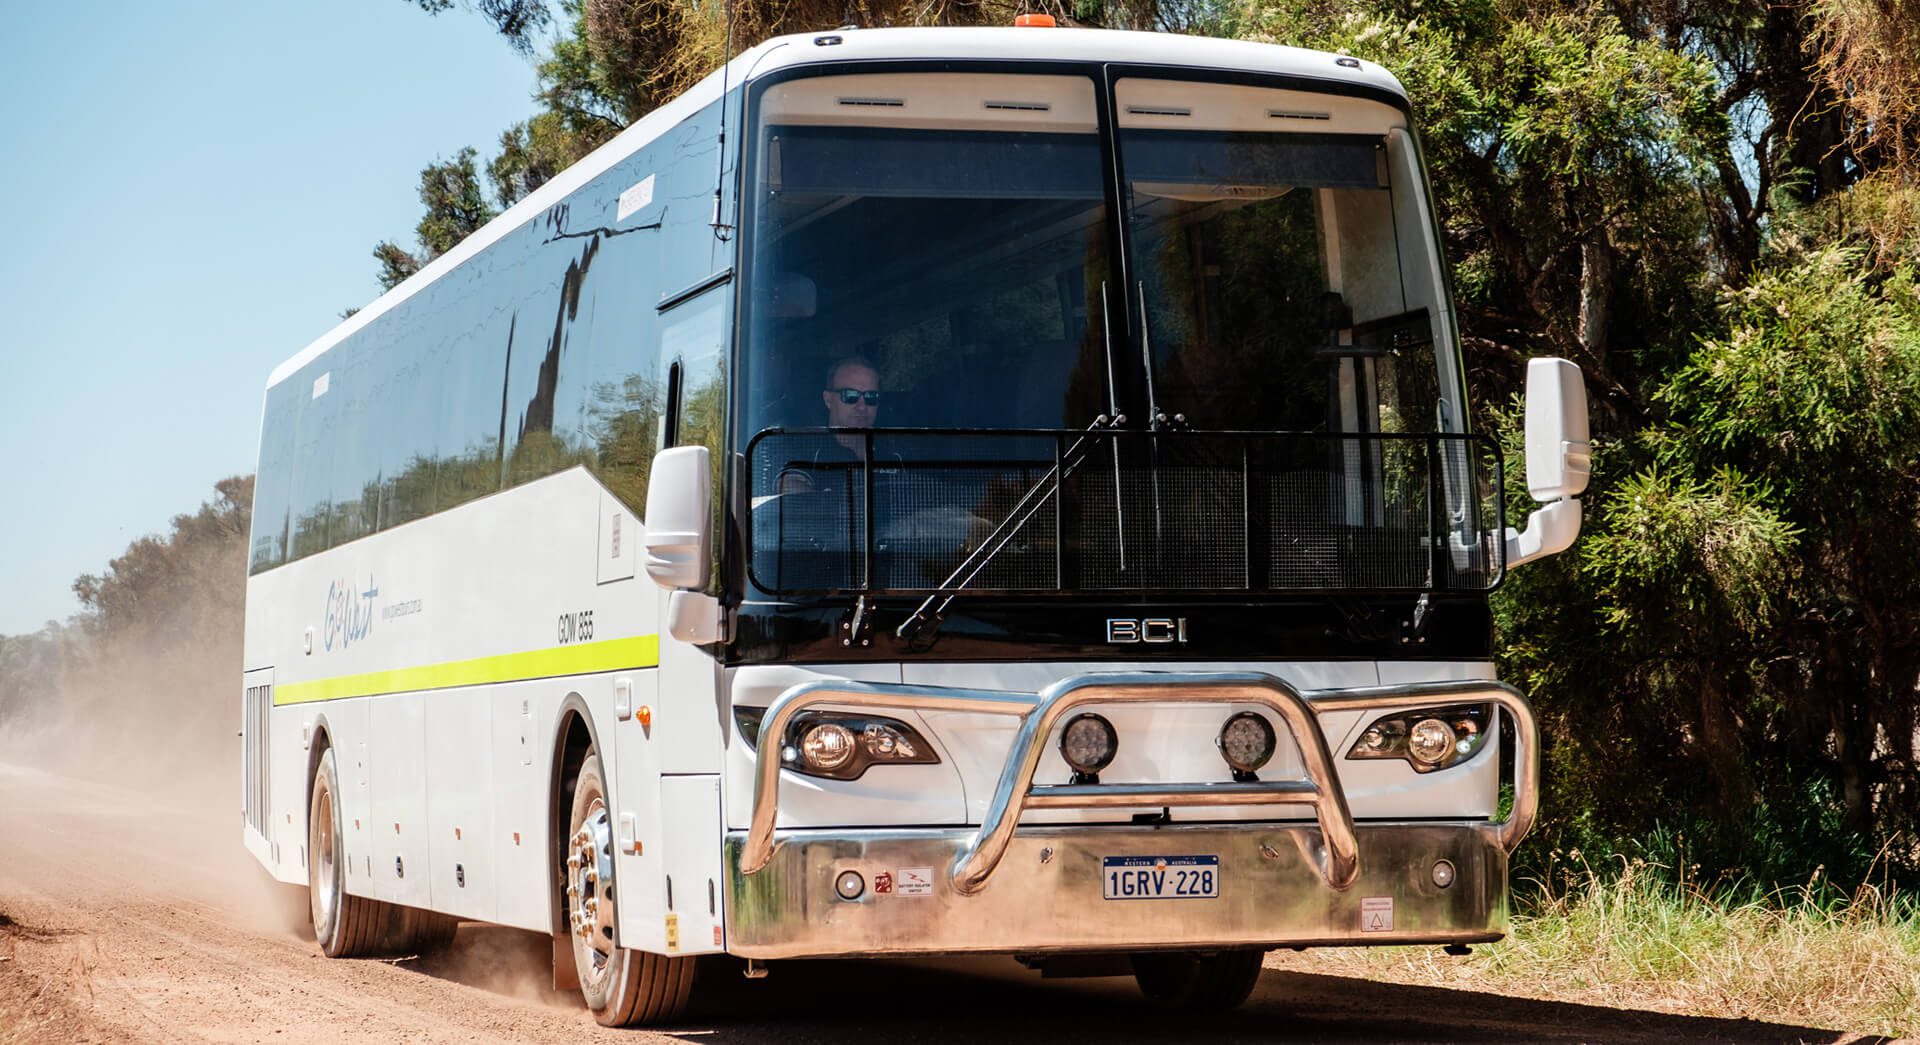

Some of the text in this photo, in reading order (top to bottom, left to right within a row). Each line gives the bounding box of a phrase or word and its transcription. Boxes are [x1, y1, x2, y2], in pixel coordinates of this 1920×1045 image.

[558, 610, 594, 644] GOW 855
[1106, 618, 1187, 643] BCI
